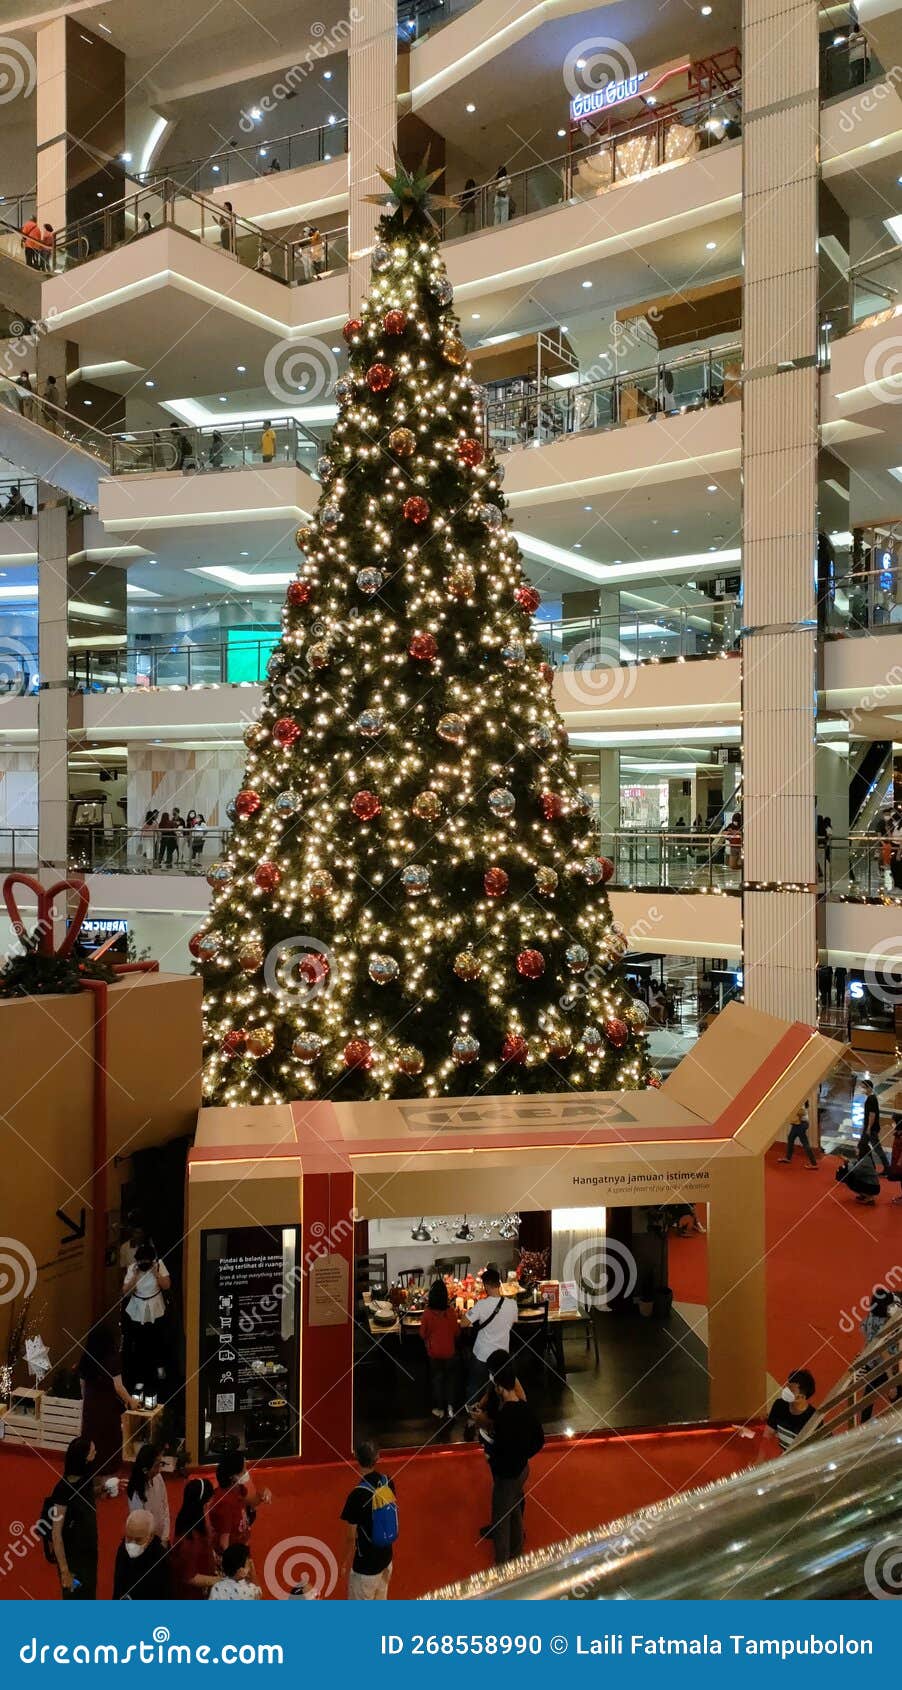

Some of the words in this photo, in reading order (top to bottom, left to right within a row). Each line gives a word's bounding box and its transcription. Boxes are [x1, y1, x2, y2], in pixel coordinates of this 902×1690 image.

[427, 1106, 600, 1123] IKEA
[572, 1173, 626, 1186] Hangatnya
[627, 1173, 664, 1184] jamuan
[665, 1170, 710, 1182] istimewa
[220, 1257, 238, 1265] Pindai
[245, 1255, 266, 1263] belanja
[219, 1264, 234, 1272] yang
